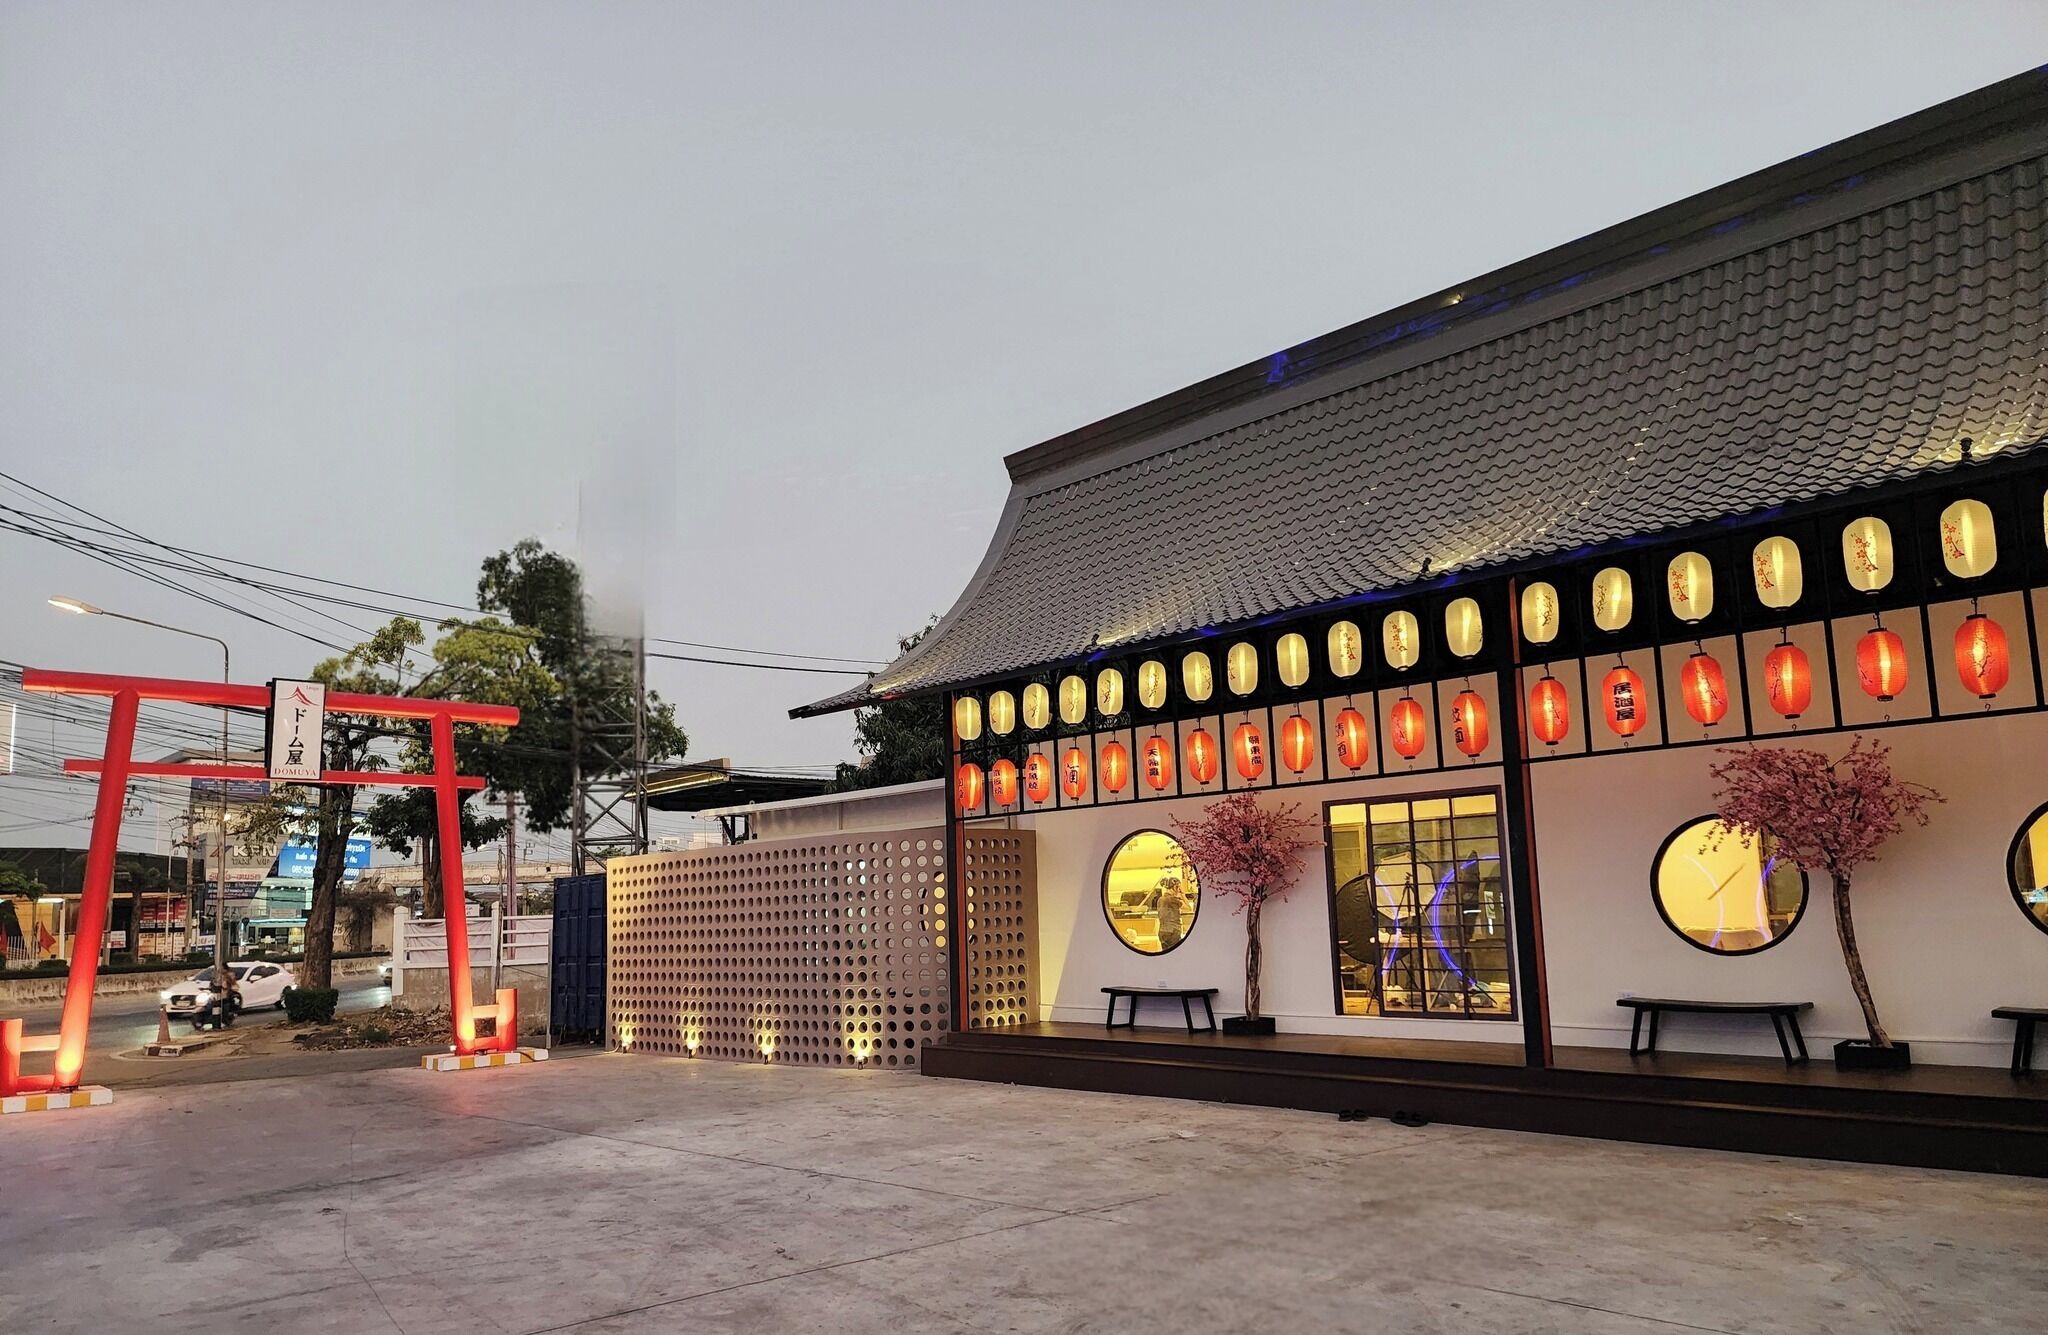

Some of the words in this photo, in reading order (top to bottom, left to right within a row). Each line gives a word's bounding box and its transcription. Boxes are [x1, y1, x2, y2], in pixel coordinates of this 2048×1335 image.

[285, 707, 307, 766] ドーム屋
[274, 767, 316, 776] DOMUYA
